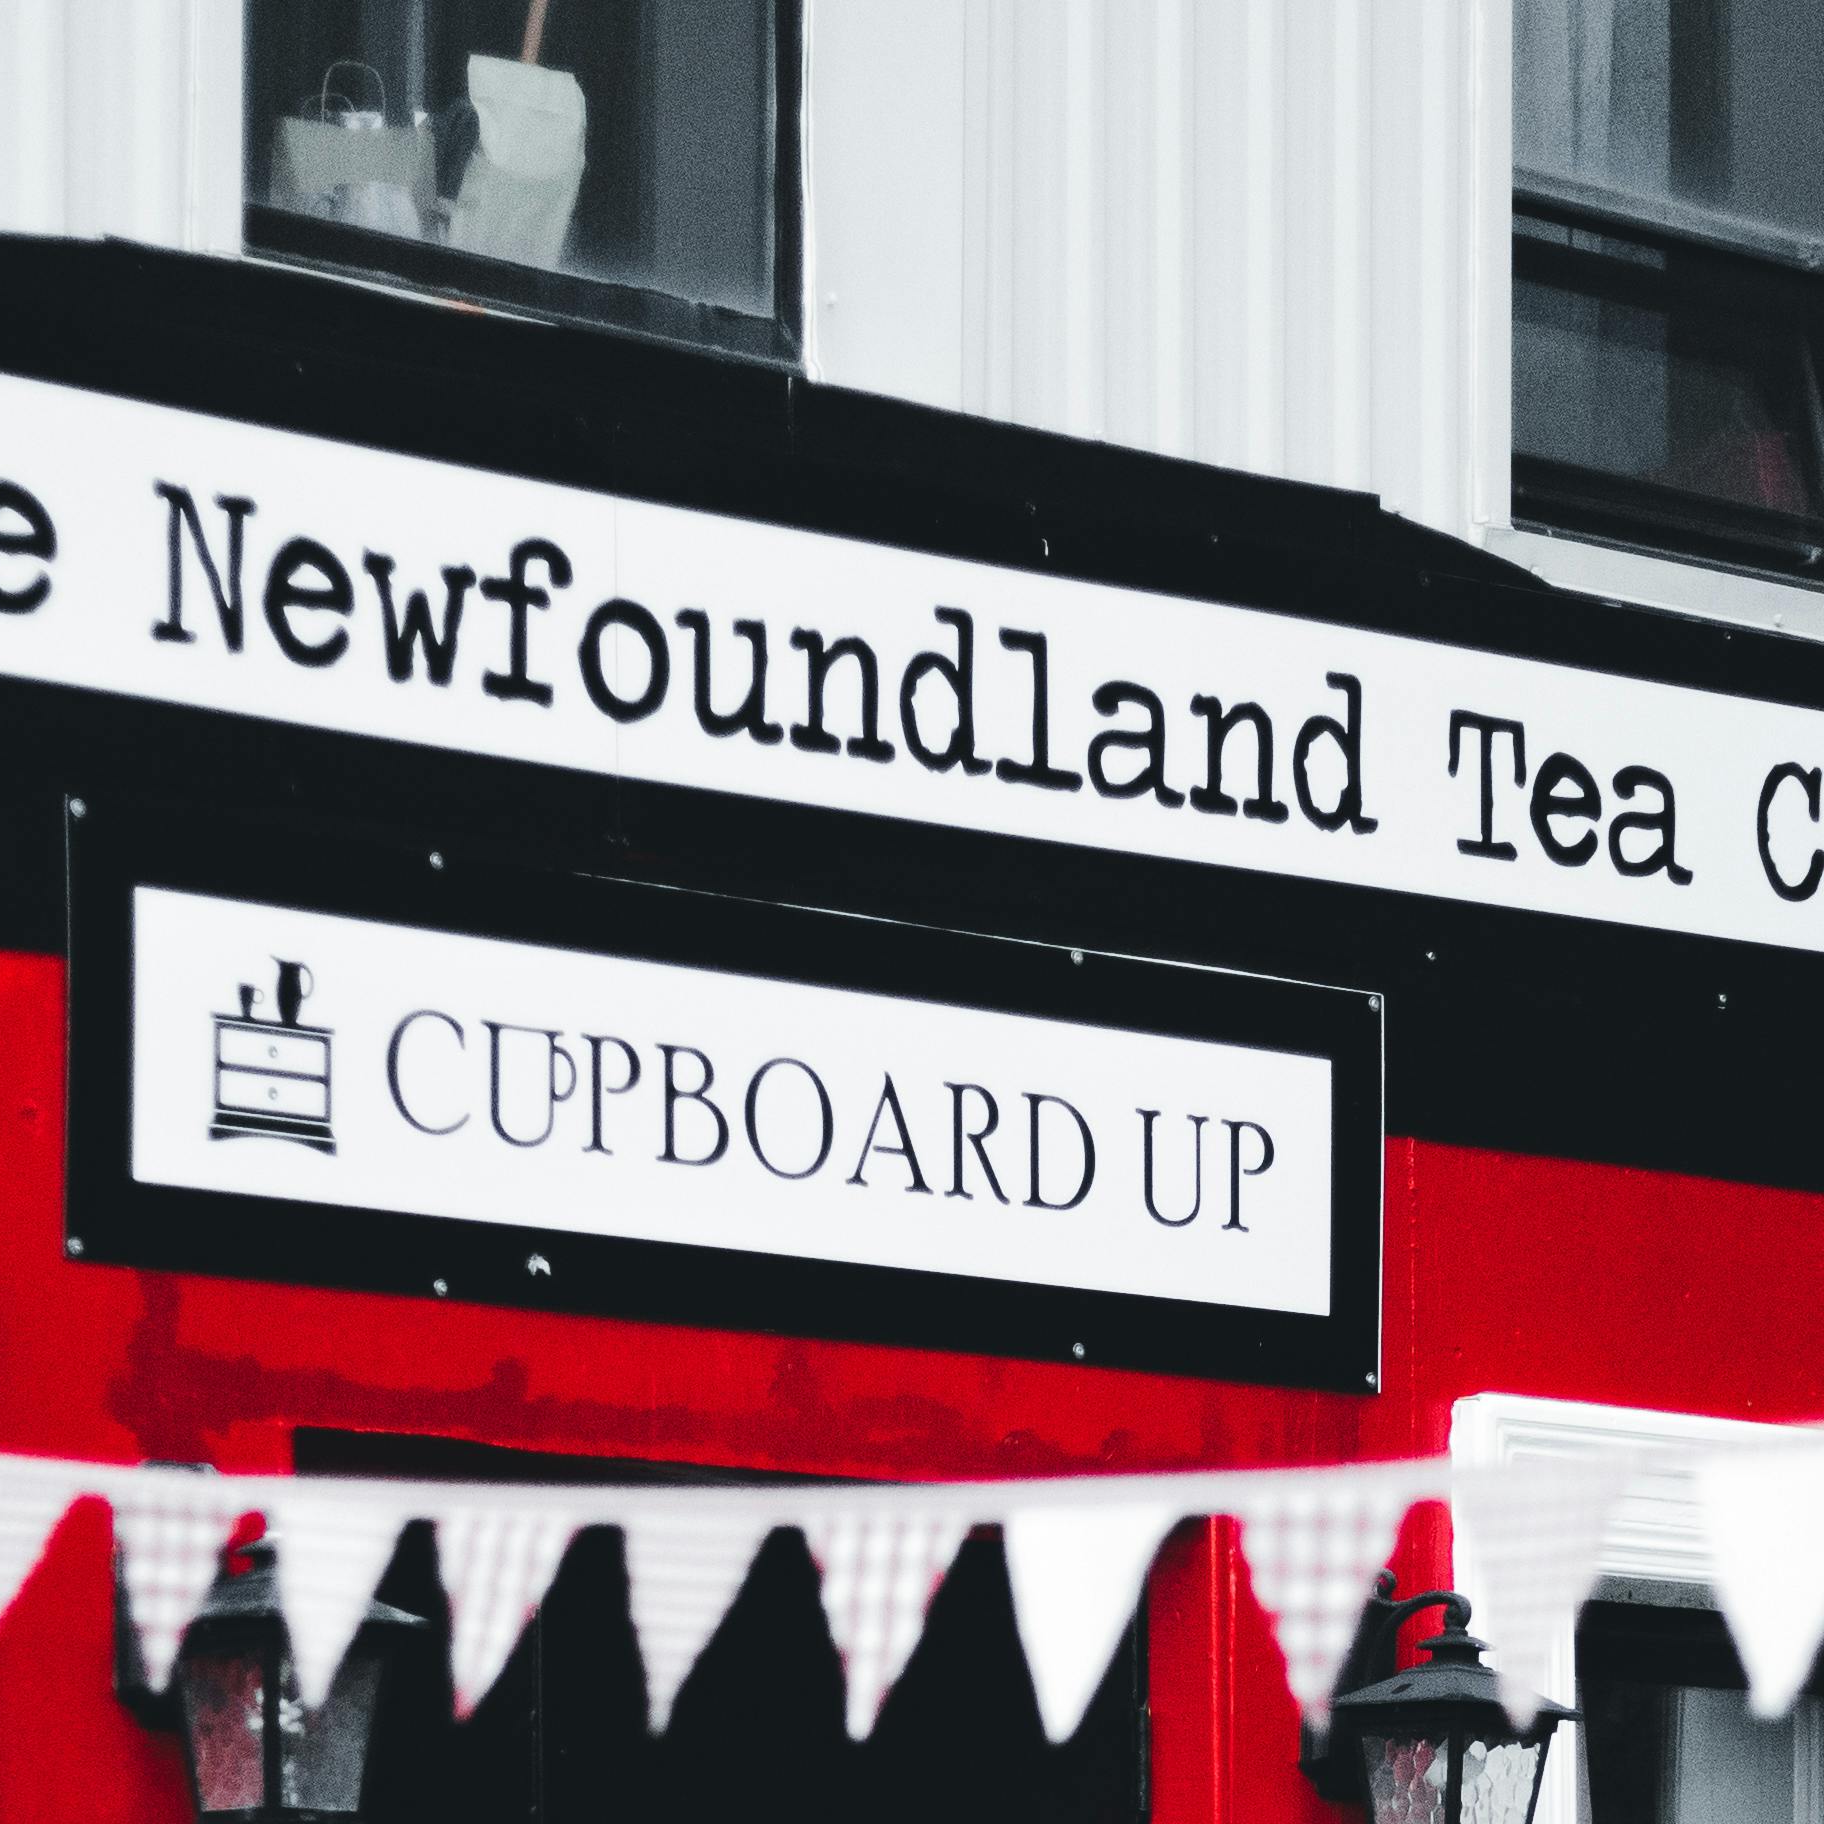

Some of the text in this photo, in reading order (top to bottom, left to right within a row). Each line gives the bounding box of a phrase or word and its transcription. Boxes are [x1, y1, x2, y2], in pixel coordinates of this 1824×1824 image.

[150, 479, 1380, 836] Newfoundland
[1446, 708, 1695, 887] Tea
[385, 1009, 1276, 1234] CUPBOARD UP
